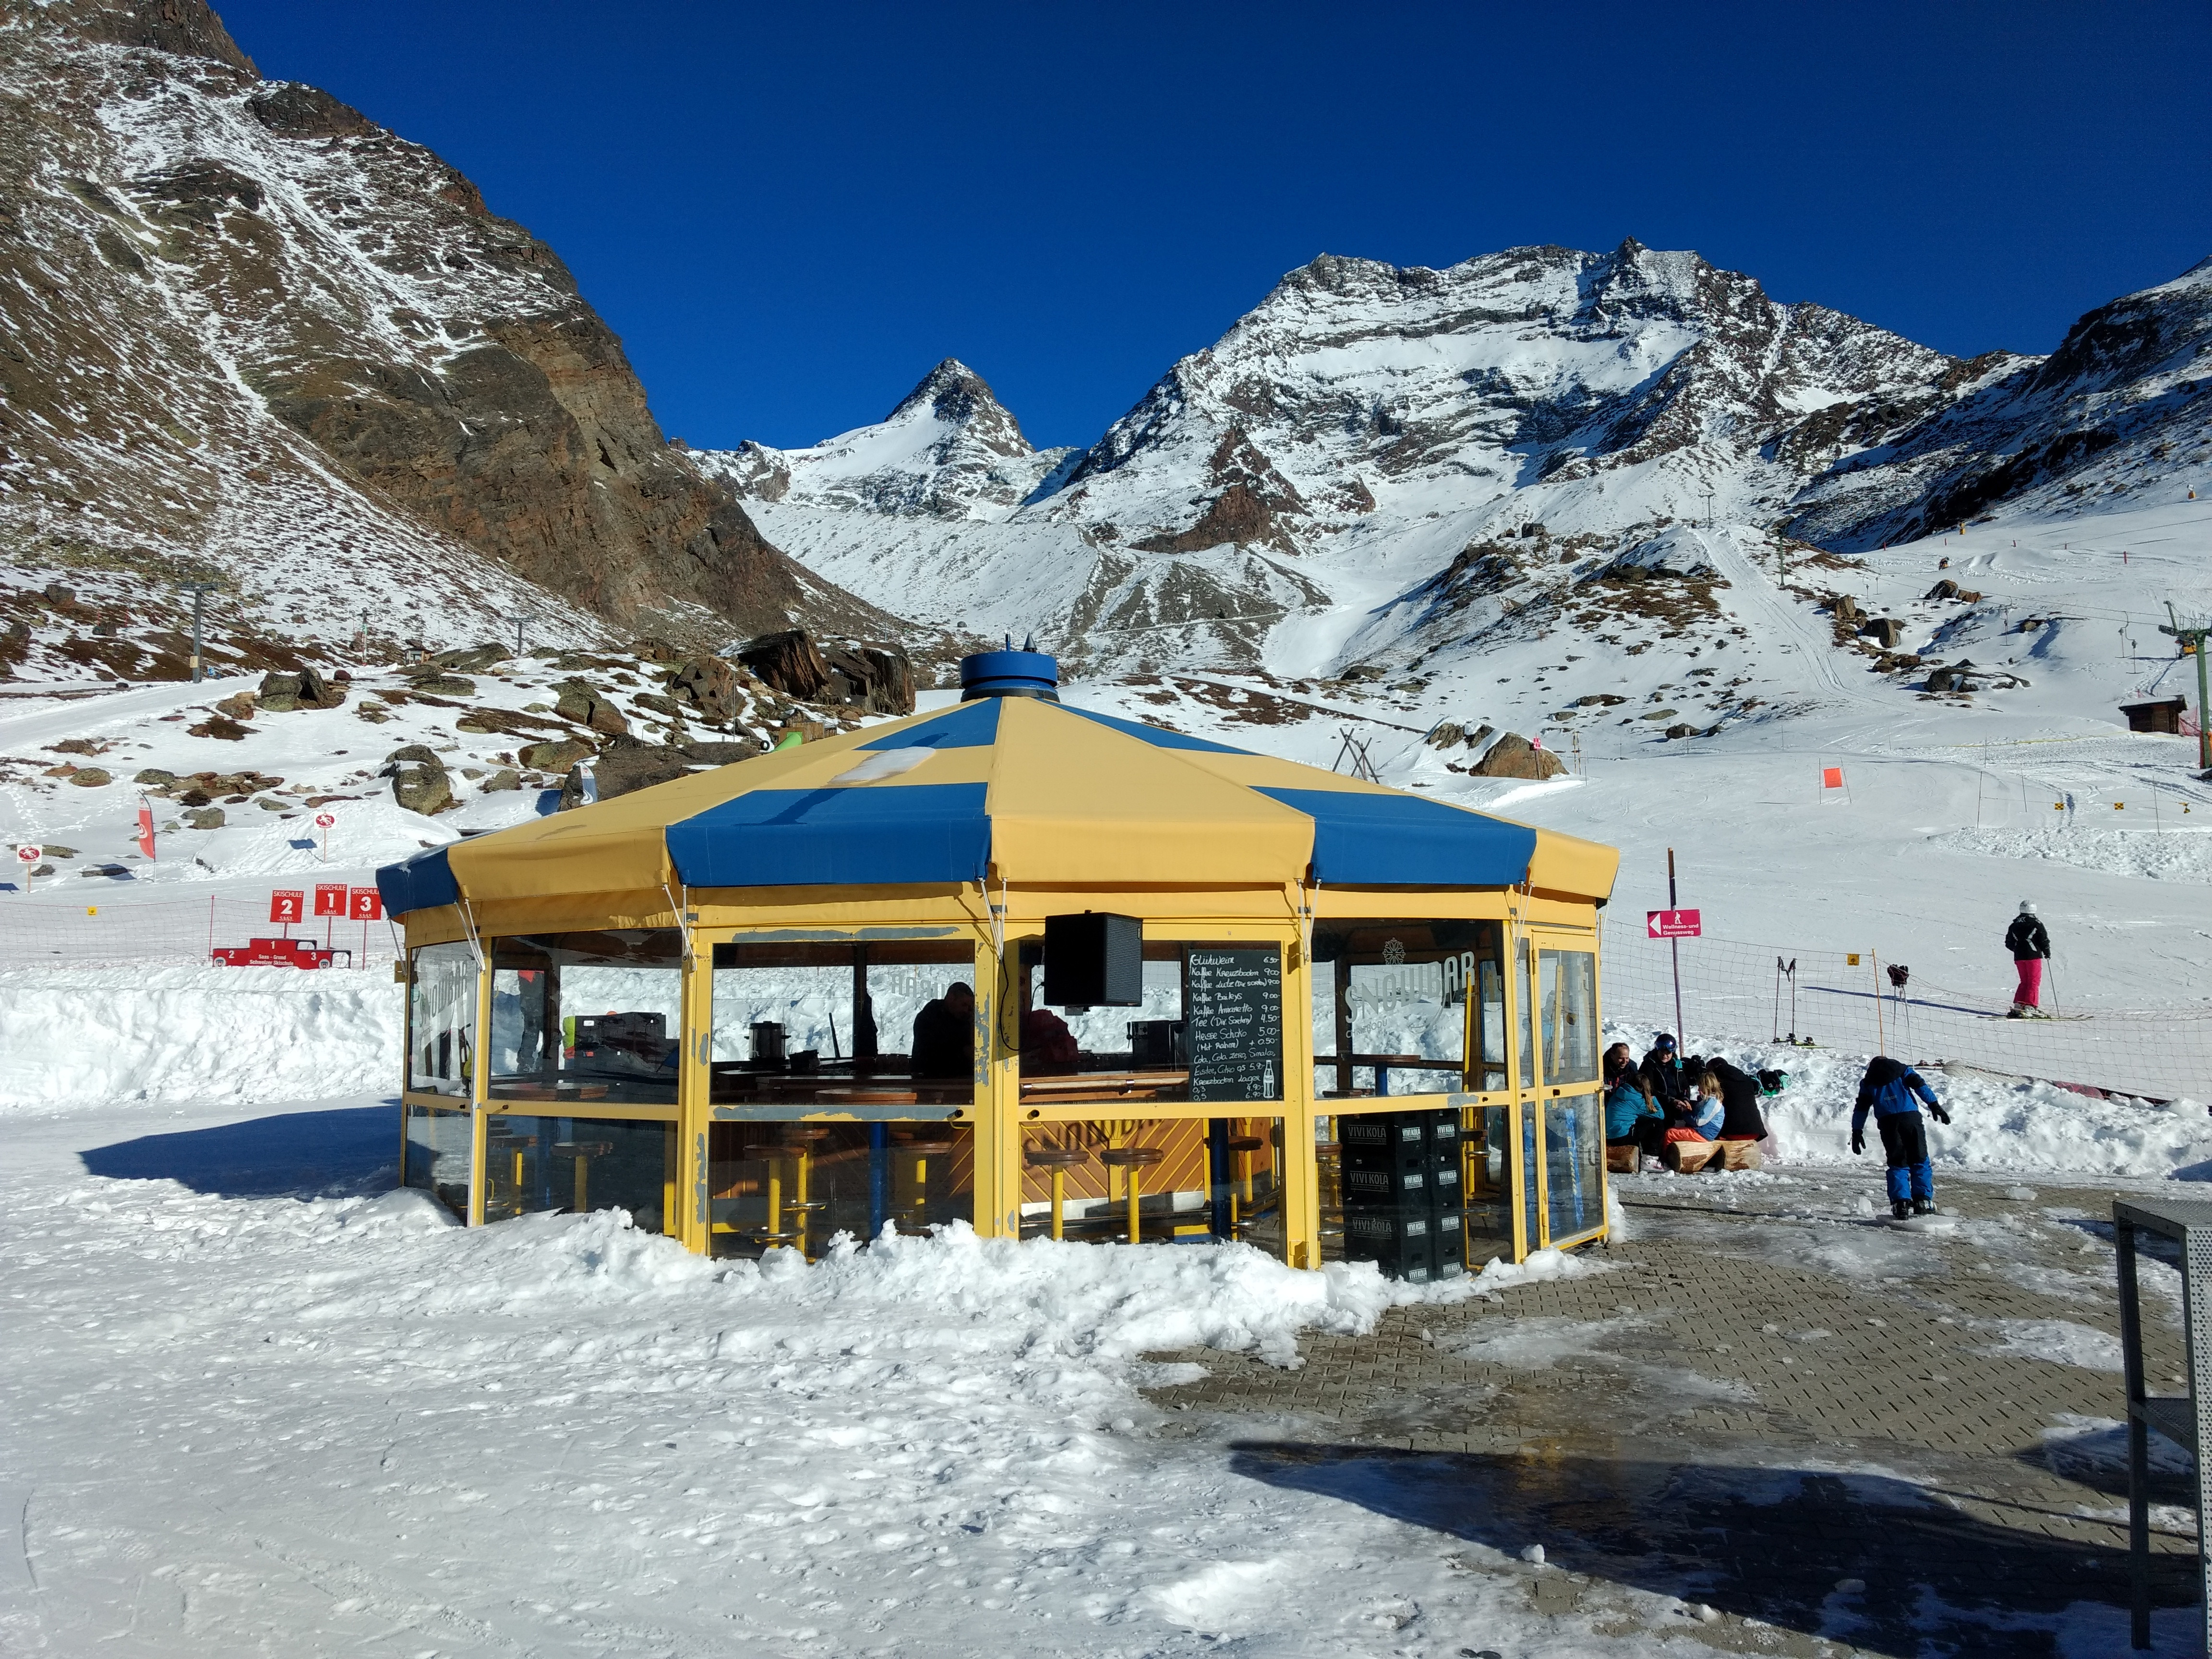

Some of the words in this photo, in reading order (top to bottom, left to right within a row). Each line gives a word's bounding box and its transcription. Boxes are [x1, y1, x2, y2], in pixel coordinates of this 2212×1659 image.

[327, 893, 334, 908] 1
[360, 896, 372, 912] 3
[280, 899, 293, 914] 2
[270, 941, 275, 950] 1
[228, 950, 234, 959] 2
[311, 952, 316, 961] 3
[1345, 951, 1475, 1024] SNOWBAR
[1214, 992, 1243, 1002] Baileys
[1218, 1003, 1253, 1014] Amaretto
[1191, 1016, 1208, 1027] Tee
[1195, 1030, 1217, 1041] Heisse
[1219, 1028, 1247, 1040] Schoko
[1215, 1038, 1238, 1049] Rahm)
[1194, 1054, 1211, 1064] Cola,
[1212, 1052, 1228, 1061] Cola
[1238, 1074, 1261, 1085] Lager
[1347, 1126, 1365, 1138] VIVI
[1366, 1127, 1386, 1138] KOLA
[1350, 1172, 1367, 1184] VIVI
[1369, 1173, 1389, 1185] KOLA
[1352, 1218, 1370, 1231] VIVI
[1371, 1220, 1392, 1232] KOLA
[1441, 1218, 1450, 1226] VIVI
[1407, 1224, 1416, 1232] VIVI
[1418, 1269, 1427, 1277] KOLA
